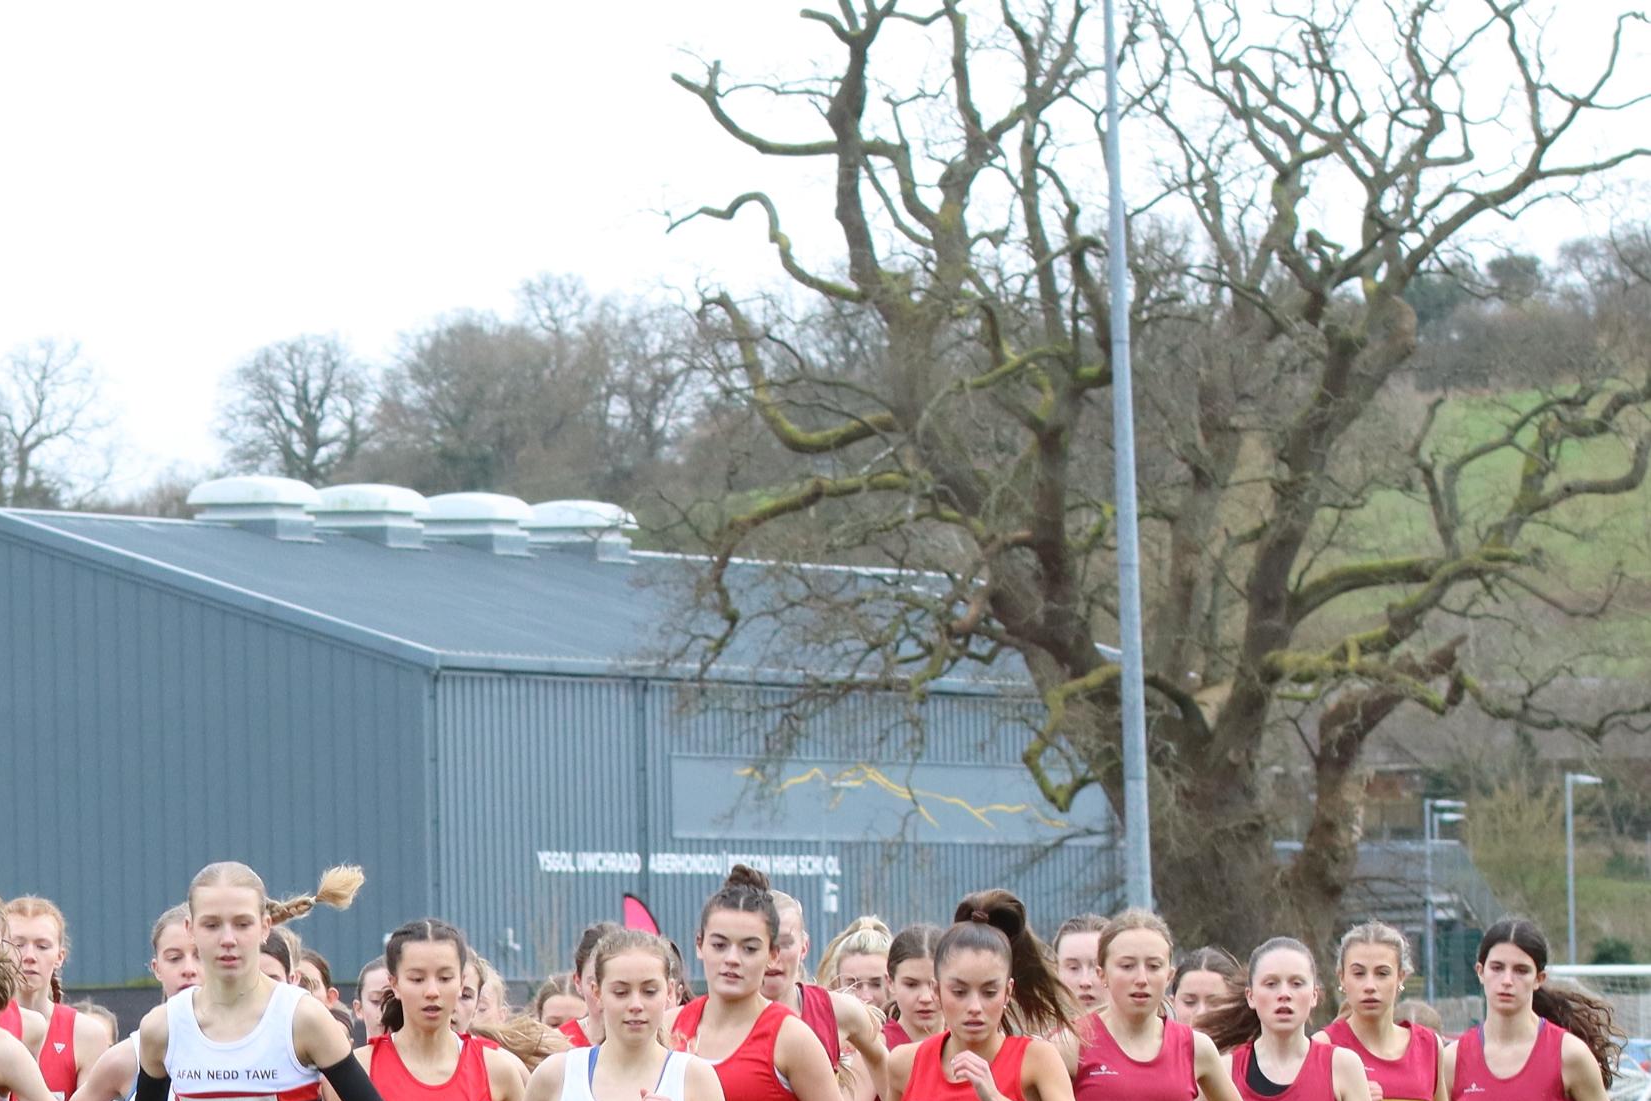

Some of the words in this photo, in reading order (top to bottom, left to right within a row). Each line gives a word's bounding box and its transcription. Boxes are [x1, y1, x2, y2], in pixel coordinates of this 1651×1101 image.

[537, 851, 576, 872] YSGOL
[772, 855, 798, 876] HIGH
[177, 1070, 201, 1080] AFAN
[207, 1070, 239, 1080] NEDD
[245, 1069, 278, 1080] TAWE
